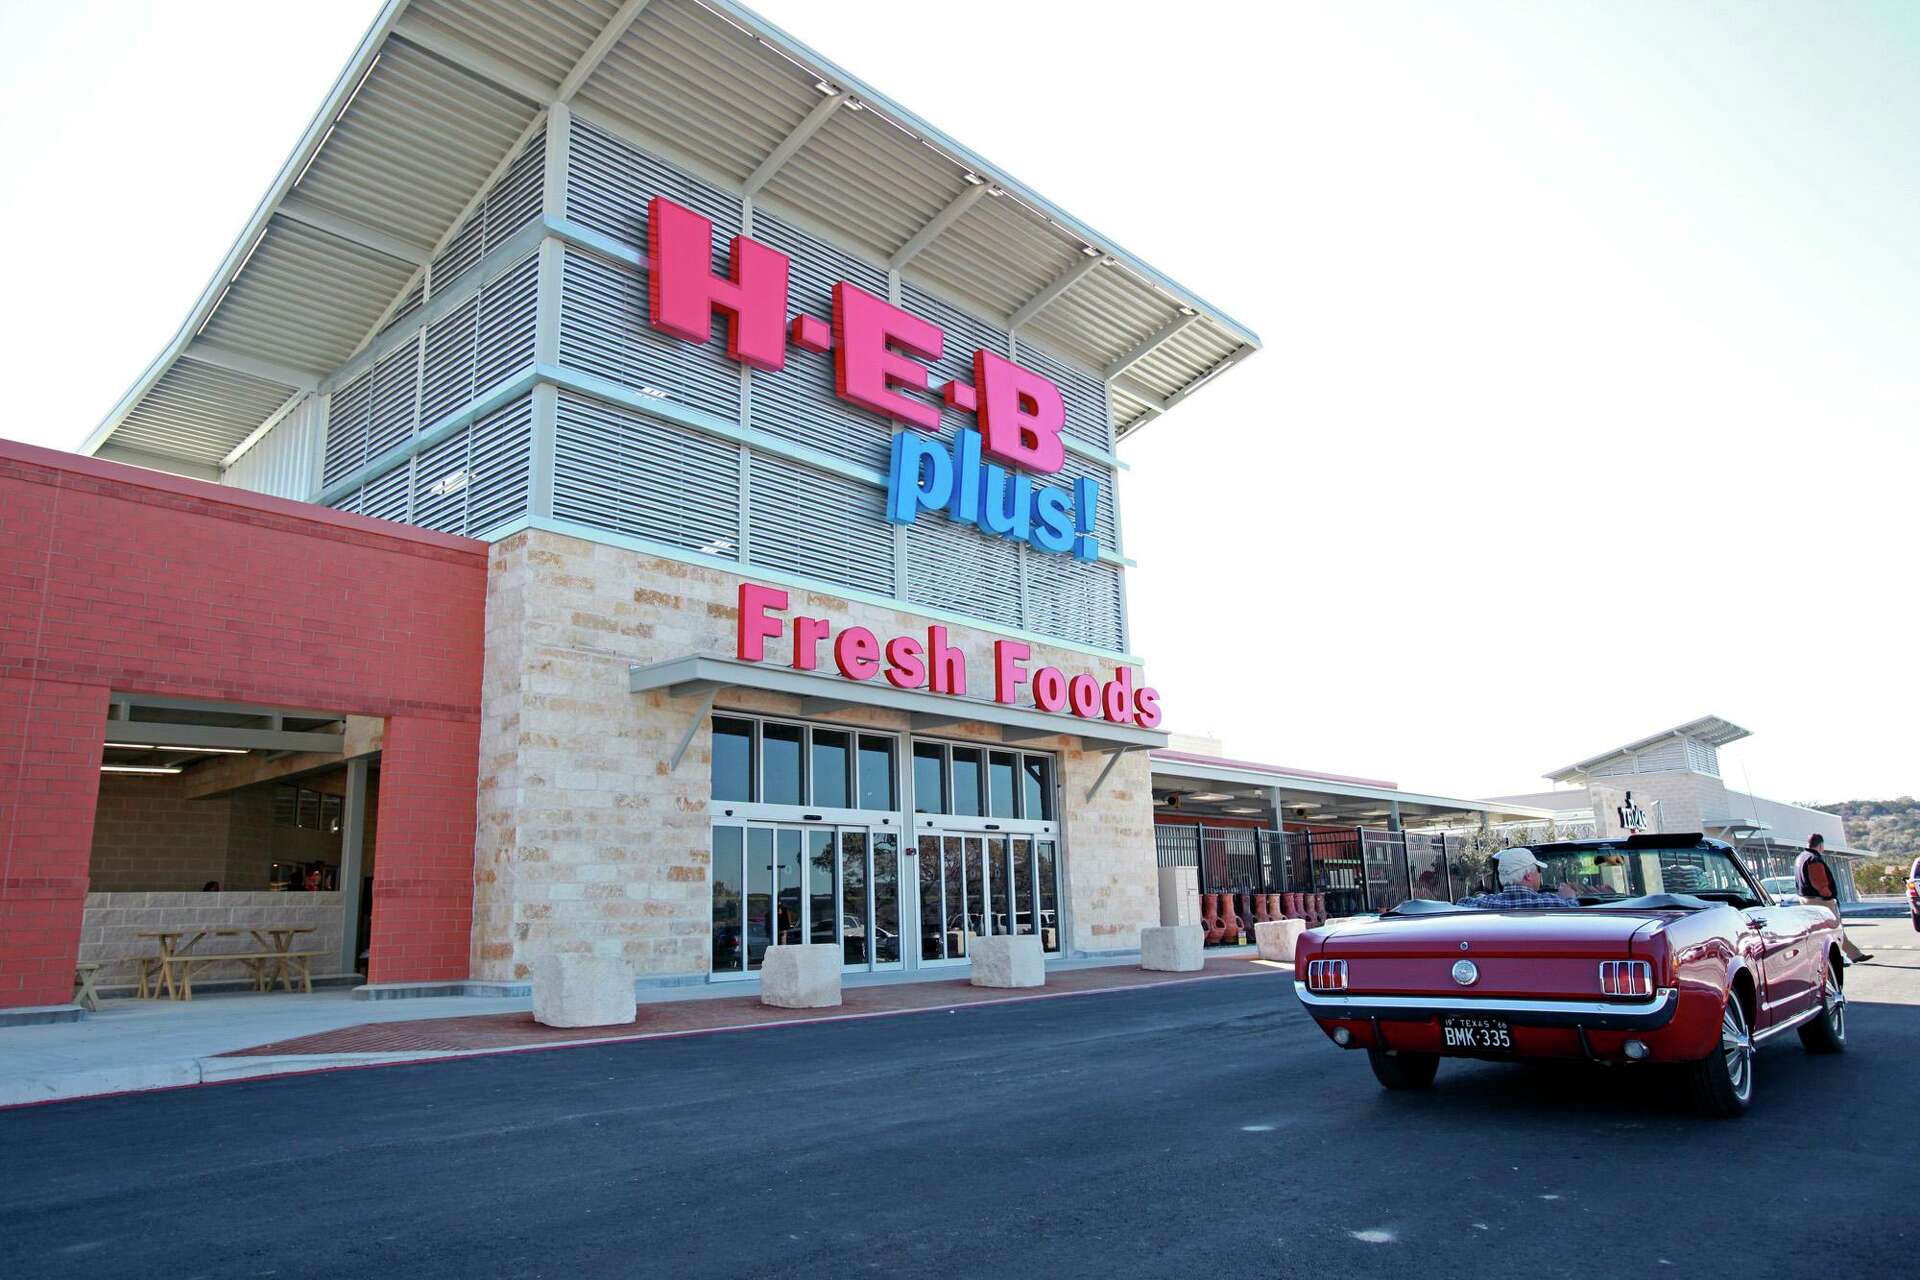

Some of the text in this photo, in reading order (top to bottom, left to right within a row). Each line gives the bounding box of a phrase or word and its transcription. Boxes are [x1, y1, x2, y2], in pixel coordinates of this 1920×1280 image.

[887, 428, 1098, 563] plus!
[737, 583, 1162, 728] Fresh Foods
[1460, 1019, 1490, 1028] TEXAS
